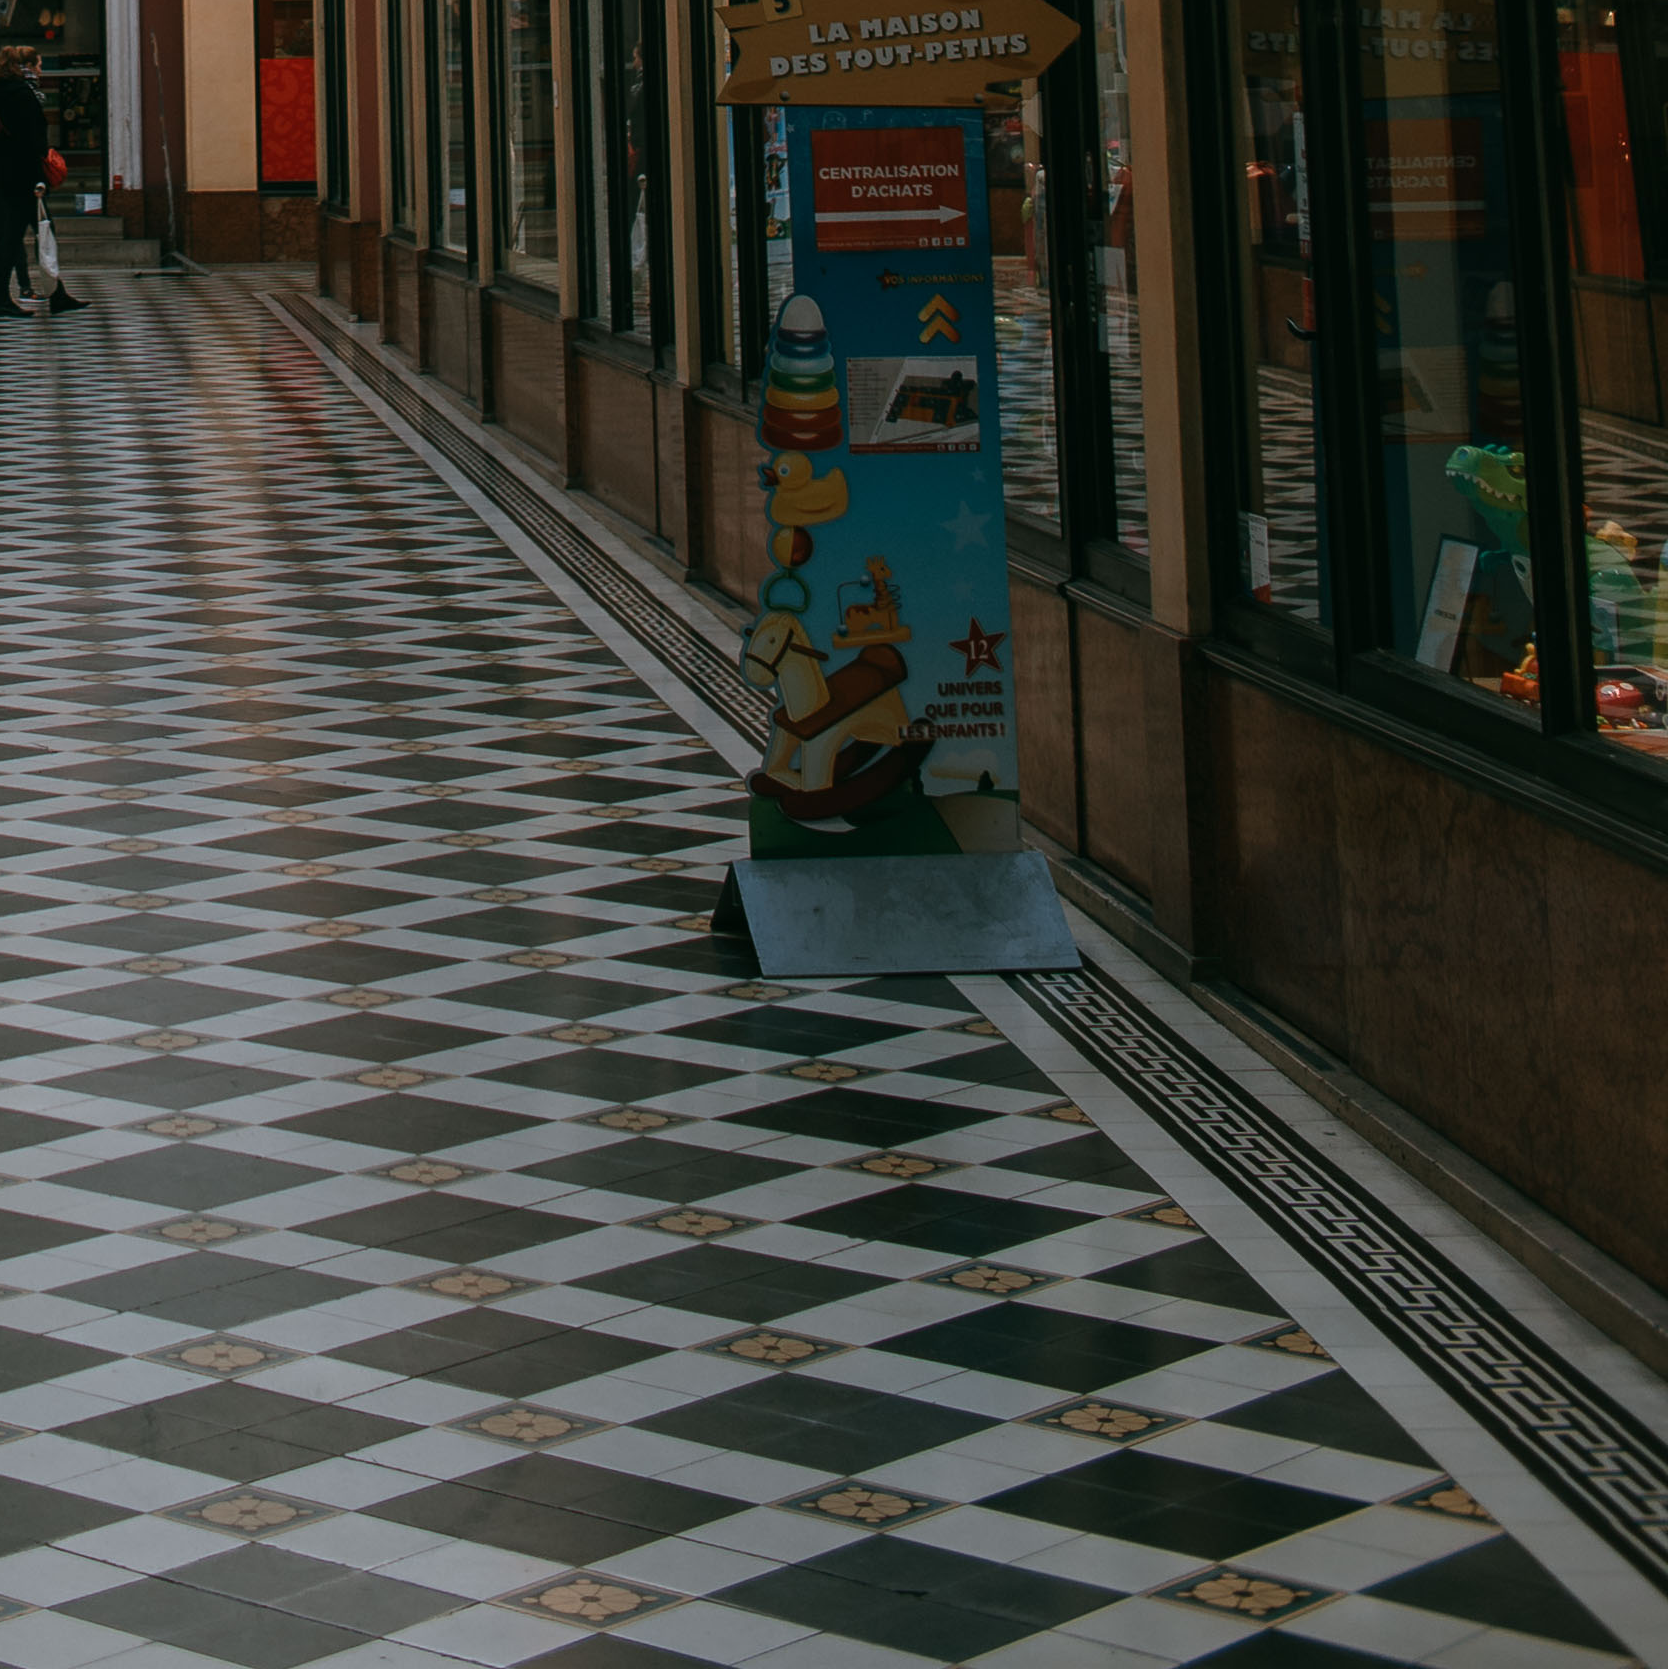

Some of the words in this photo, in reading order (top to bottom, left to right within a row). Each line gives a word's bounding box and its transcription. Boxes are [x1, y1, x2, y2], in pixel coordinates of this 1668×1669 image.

[808, 22, 850, 45] LA
[859, 8, 981, 40] MAISON
[769, 52, 828, 78] DES
[835, 33, 1029, 71] TOUT-PETITS
[819, 165, 960, 180] CENTRALISATION
[851, 184, 933, 198] D'ACHATS
[883, 274, 905, 285] VOS
[908, 272, 985, 285] INFORMATIONS
[969, 639, 989, 660] 12
[938, 681, 1003, 697] UNIVERS
[925, 703, 958, 719] QUE
[962, 702, 1004, 716] POUR
[898, 725, 925, 740] LES
[928, 722, 998, 739] ENFANTS
